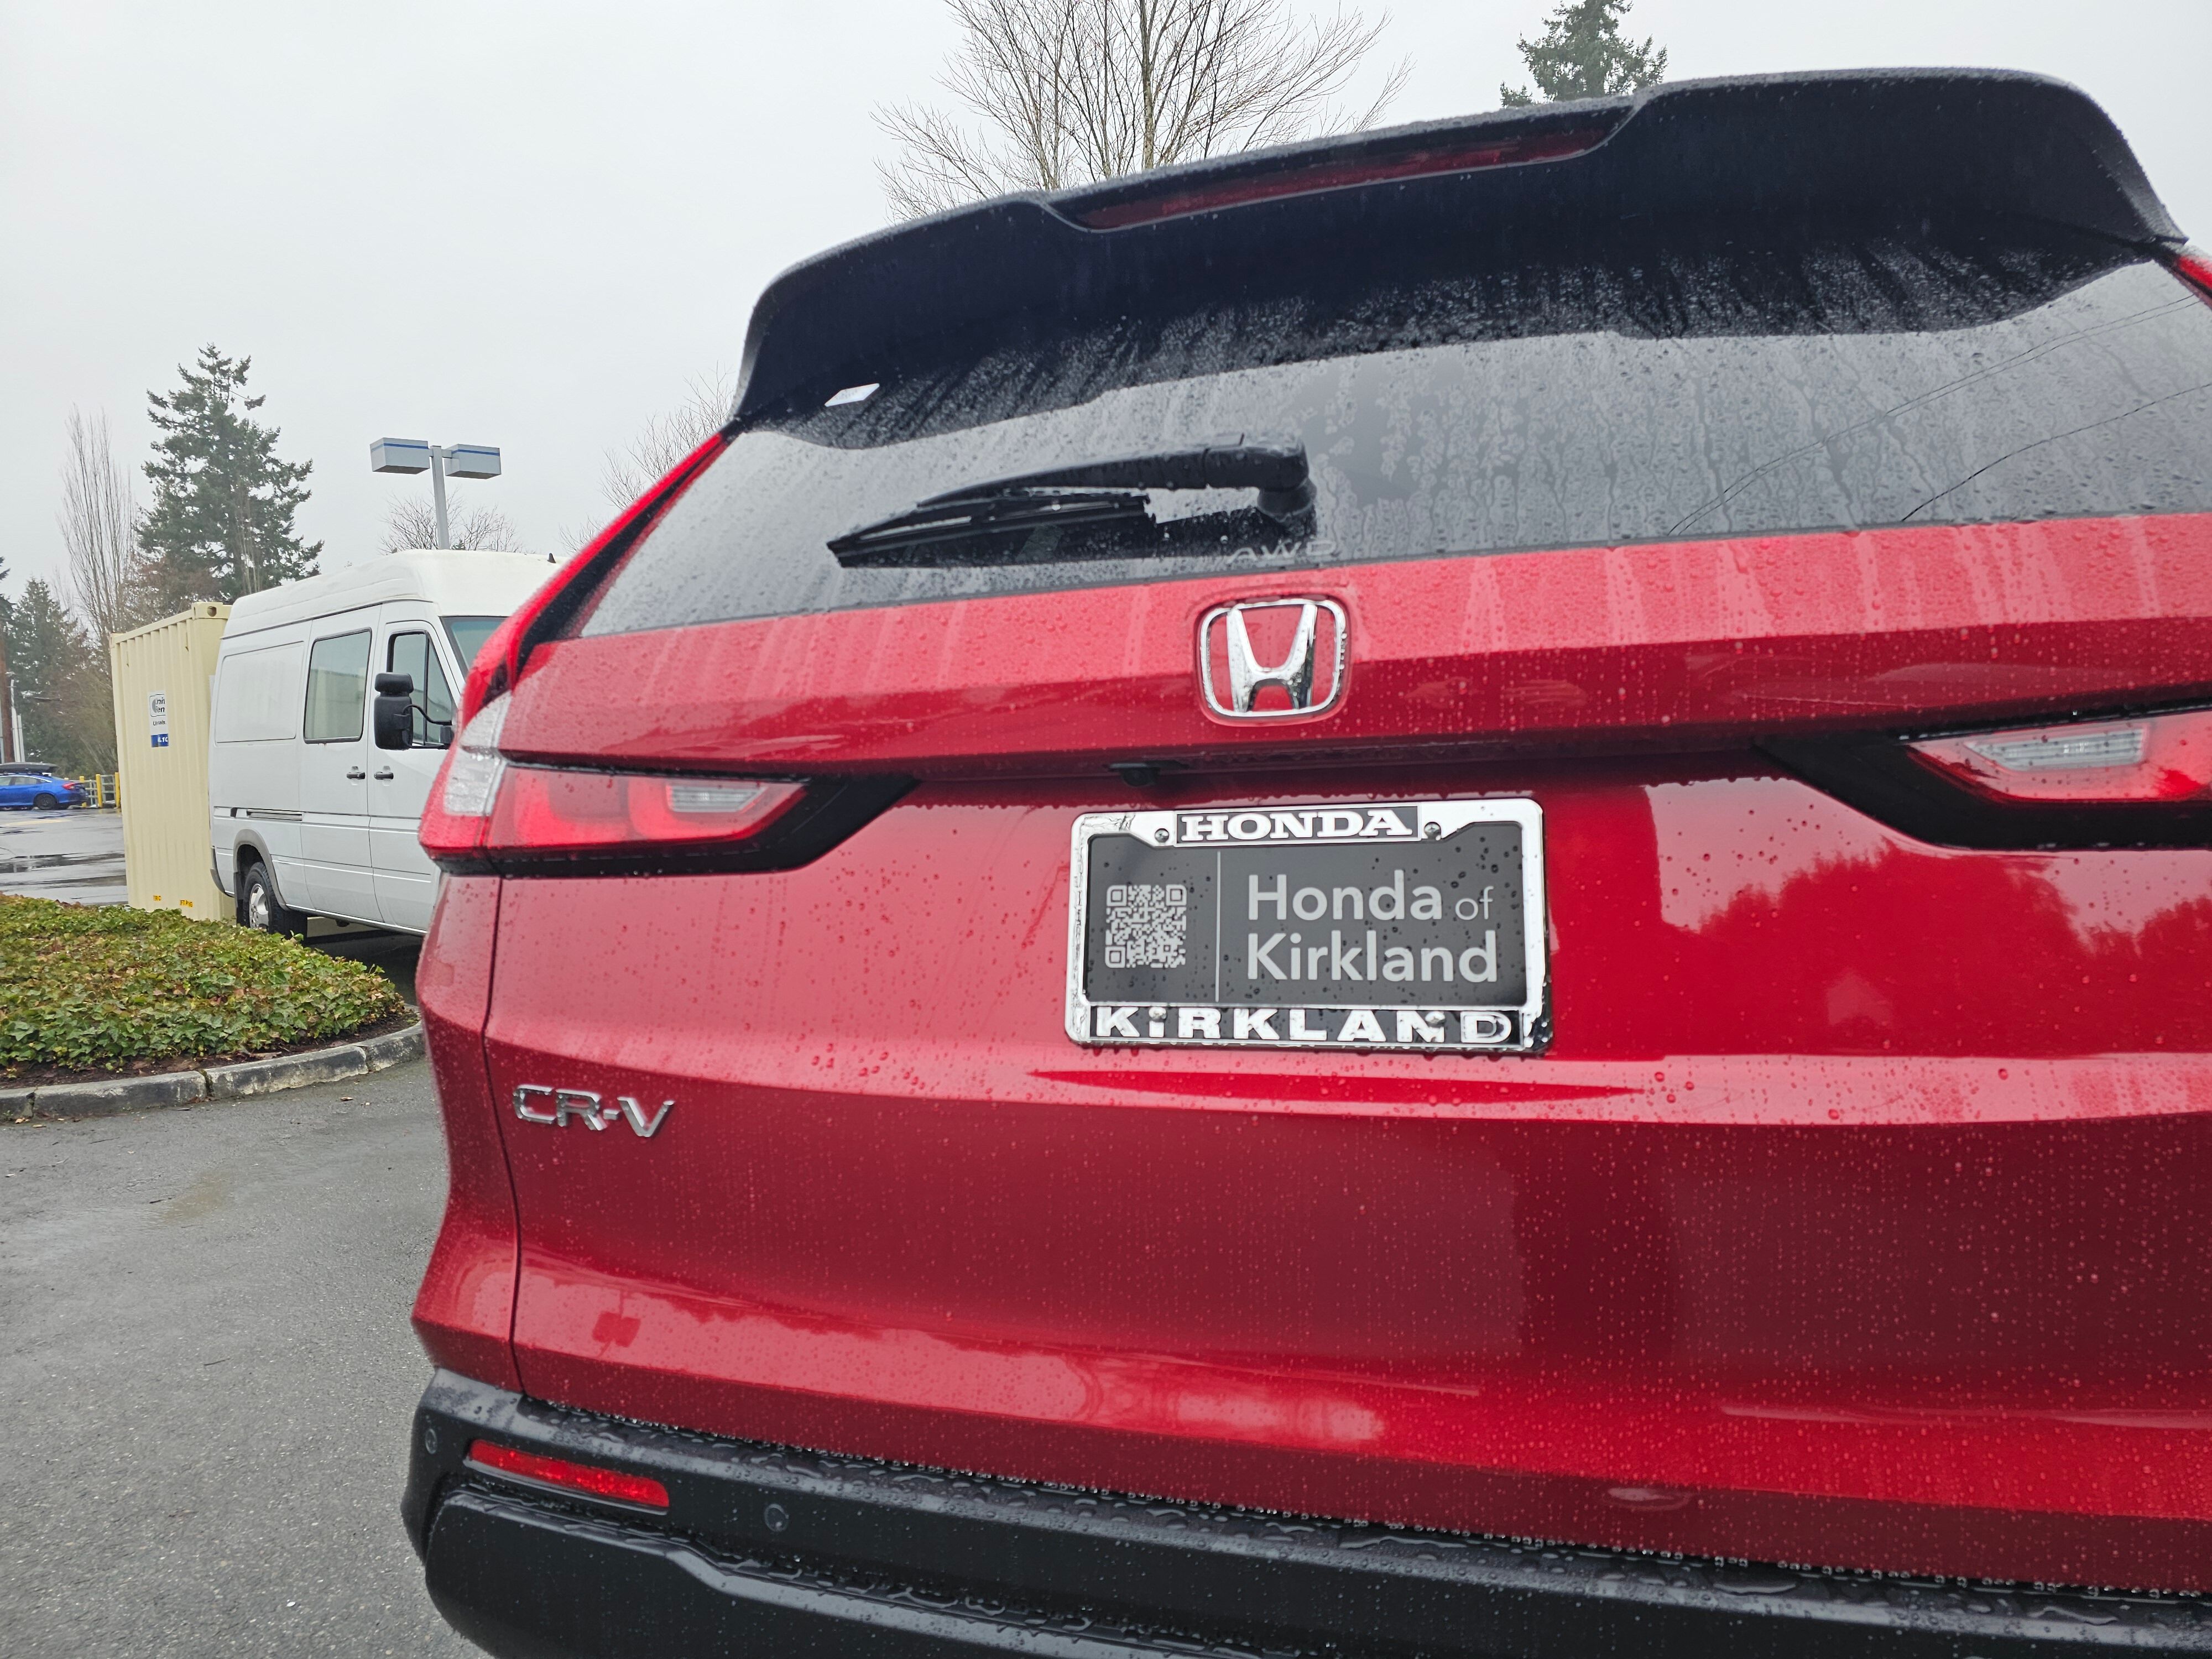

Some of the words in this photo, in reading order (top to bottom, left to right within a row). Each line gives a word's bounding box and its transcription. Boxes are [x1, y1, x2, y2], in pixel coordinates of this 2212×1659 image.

[1226, 539, 1337, 564] AWD
[1181, 809, 1413, 842] HONDA
[1248, 869, 1442, 921] Honda
[1455, 885, 1494, 920] of
[1248, 930, 1498, 983] Kirkland
[1096, 1006, 1512, 1044] KIRKLAND
[513, 1084, 675, 1138] CR-V
